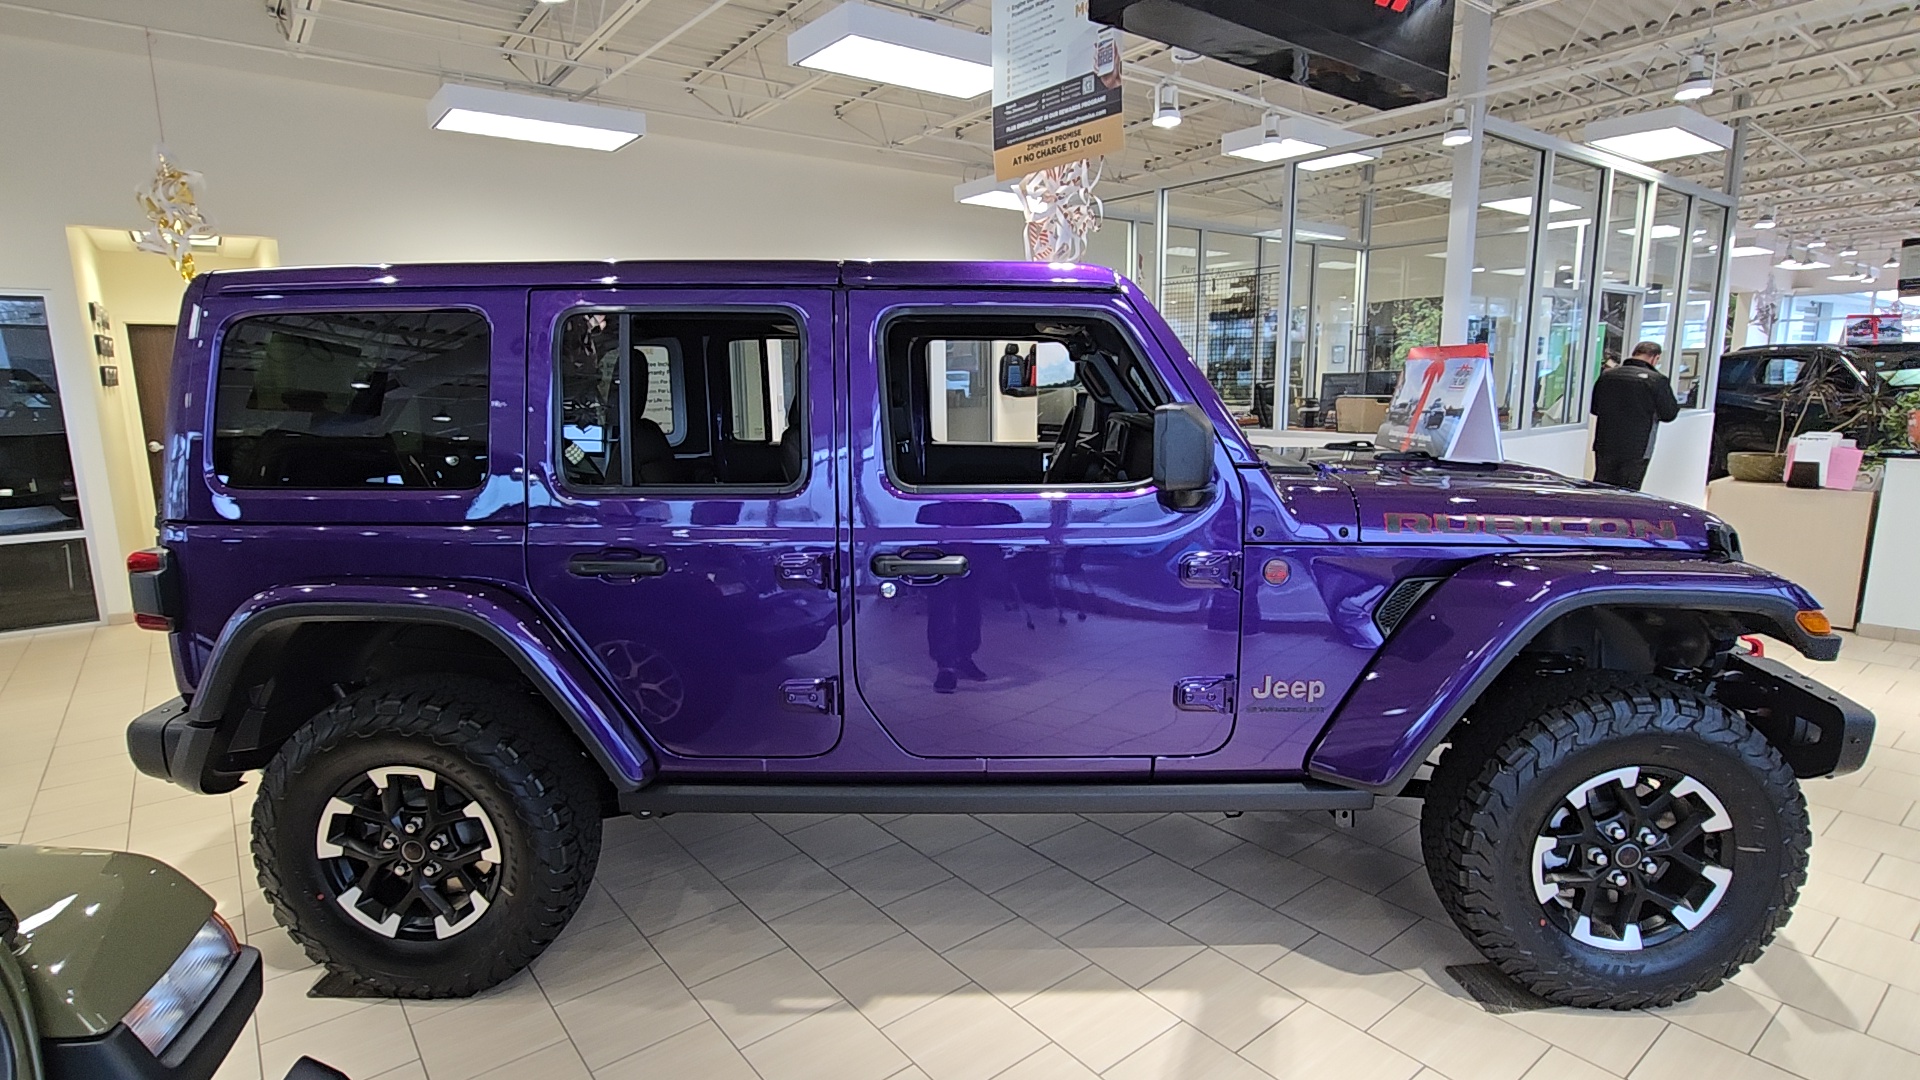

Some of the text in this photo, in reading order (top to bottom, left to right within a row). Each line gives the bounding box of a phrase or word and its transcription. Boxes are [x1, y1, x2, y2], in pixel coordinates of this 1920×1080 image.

[1059, 103, 1080, 116] REWARDS
[1013, 155, 1022, 166] AT
[1024, 153, 1034, 162] NO
[1036, 144, 1067, 159] CHARGE
[1068, 140, 1079, 150] TO
[1081, 133, 1102, 146] YOU!
[1026, 137, 1053, 151] ZIMMER'S
[1055, 129, 1082, 142] PROMISE
[1384, 512, 1677, 540] RUBICON
[1252, 674, 1326, 703] Jeep
